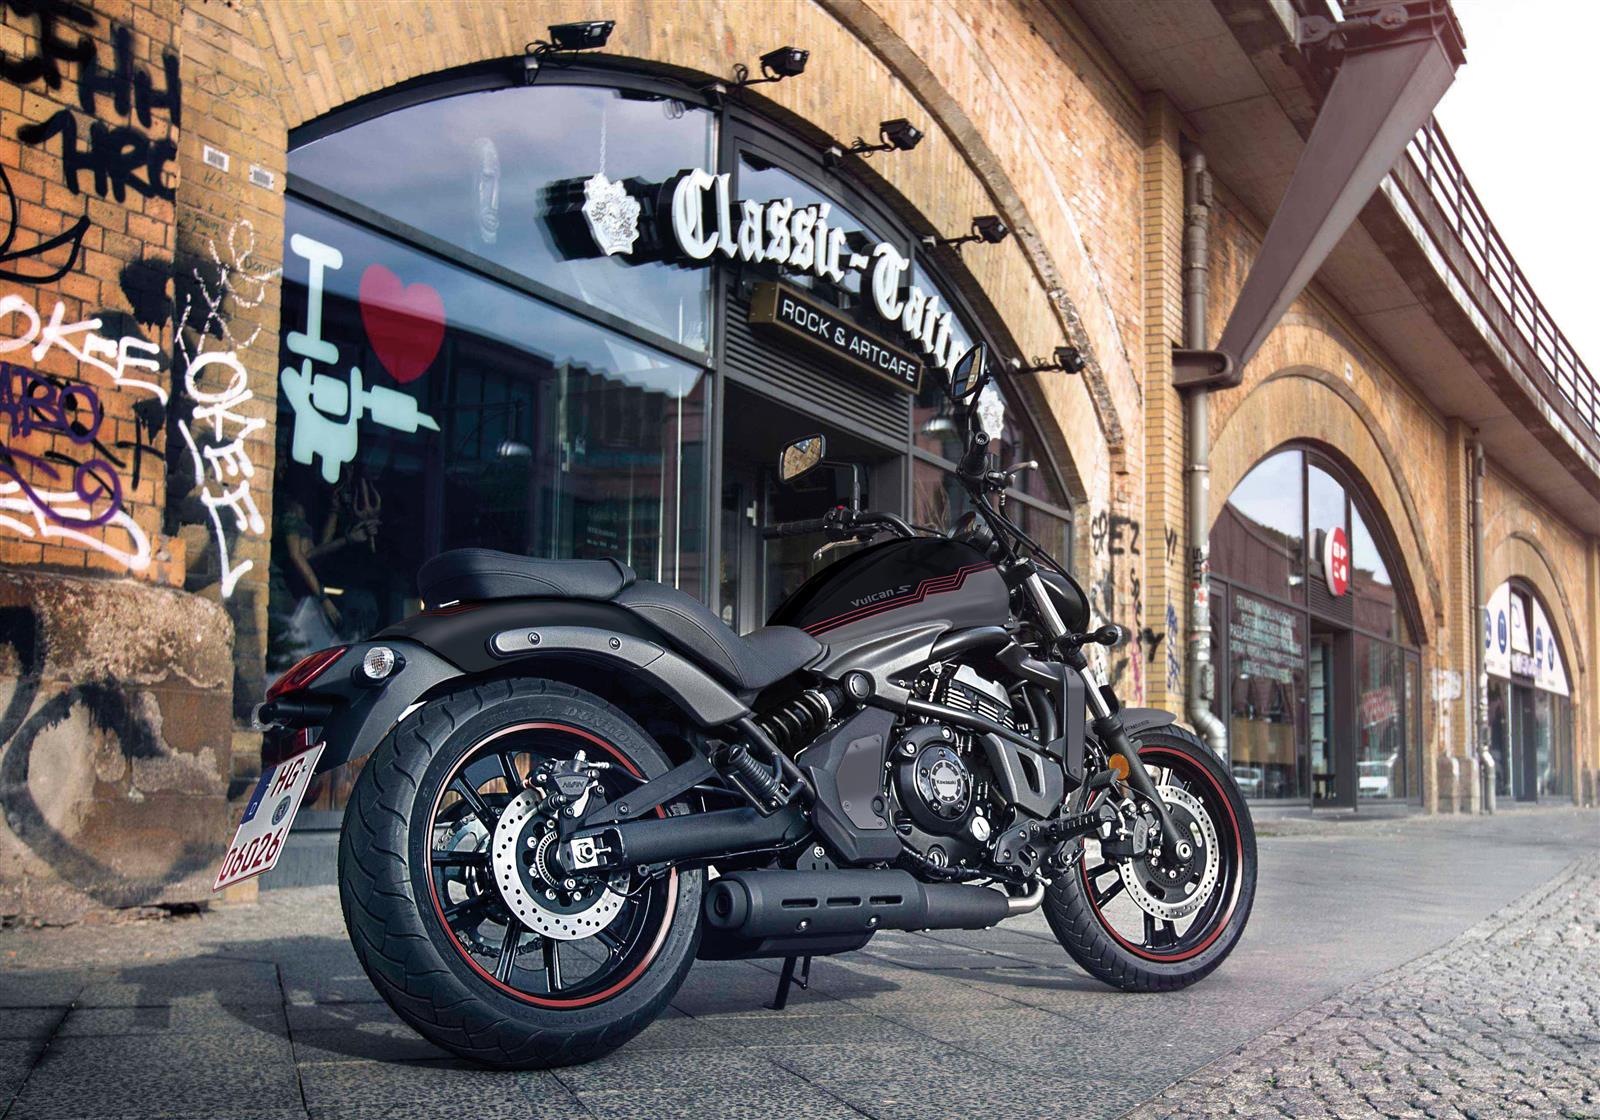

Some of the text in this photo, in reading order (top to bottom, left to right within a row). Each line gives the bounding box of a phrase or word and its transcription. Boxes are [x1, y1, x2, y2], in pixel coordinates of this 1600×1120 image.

[671, 167, 974, 402] Classic-Tatt
[781, 298, 918, 384] ROCK & ARTCAFE
[850, 584, 912, 608] Vulcan S
[270, 756, 306, 798] HG
[219, 827, 284, 882] 06026
